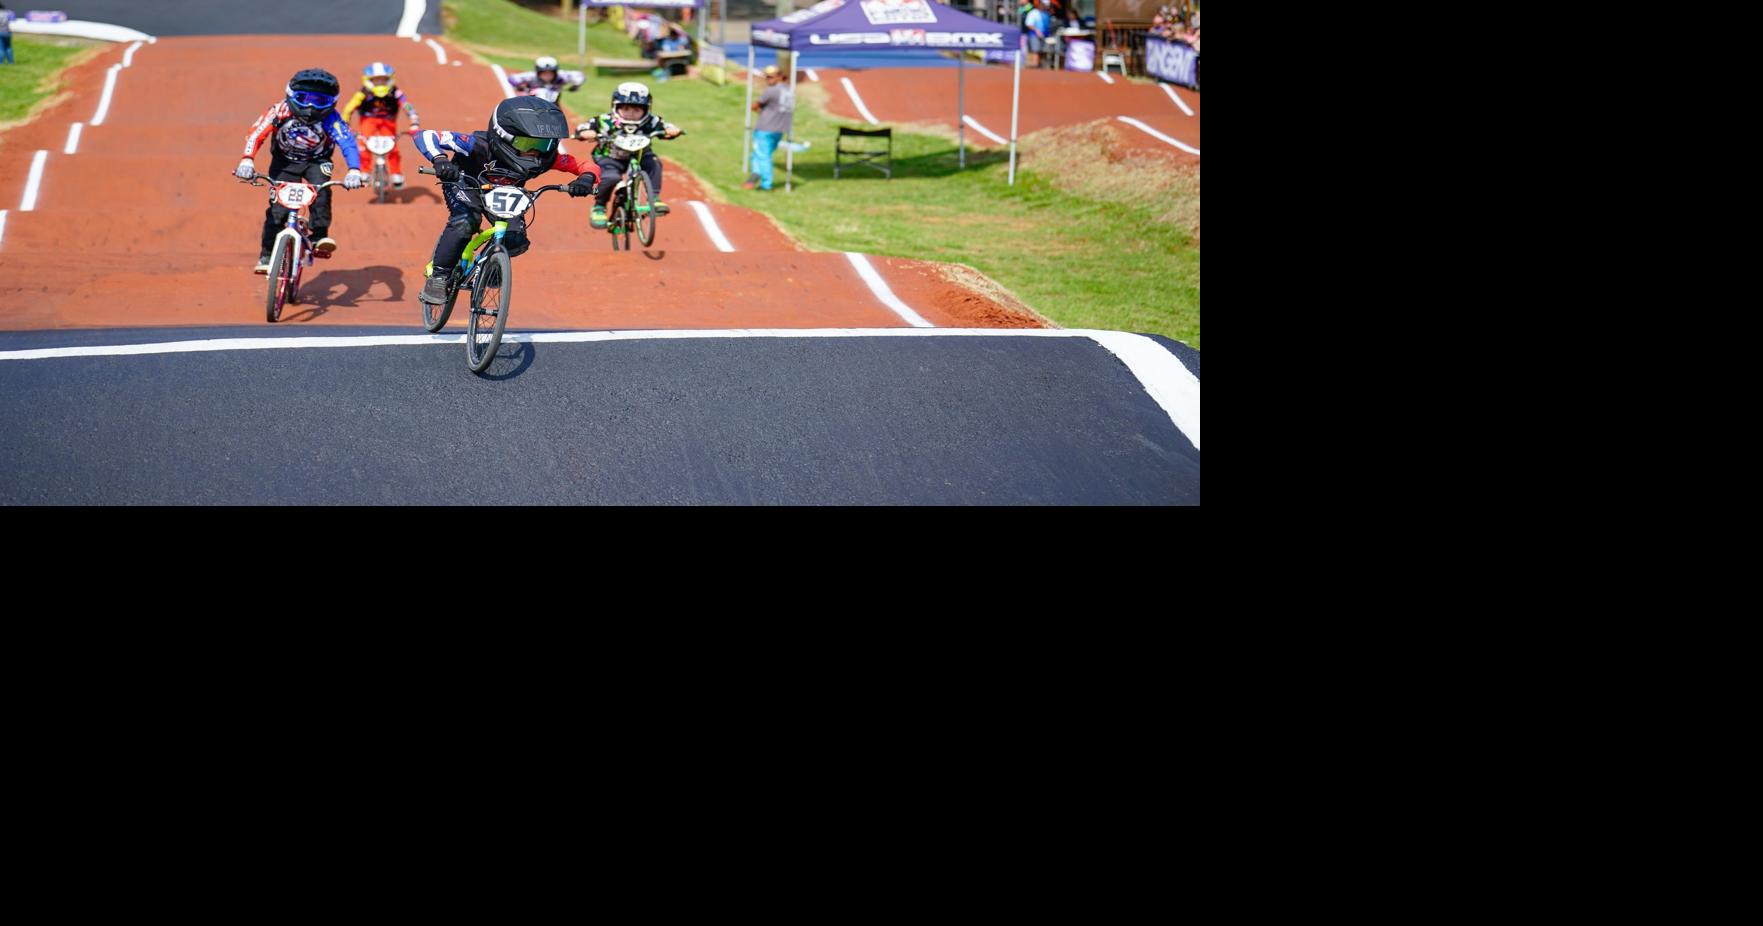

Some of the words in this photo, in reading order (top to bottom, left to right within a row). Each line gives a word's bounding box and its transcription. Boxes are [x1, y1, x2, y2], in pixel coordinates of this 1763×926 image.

[925, 32, 1004, 46] BMX
[288, 188, 304, 202] 28
[492, 191, 523, 212] 57
